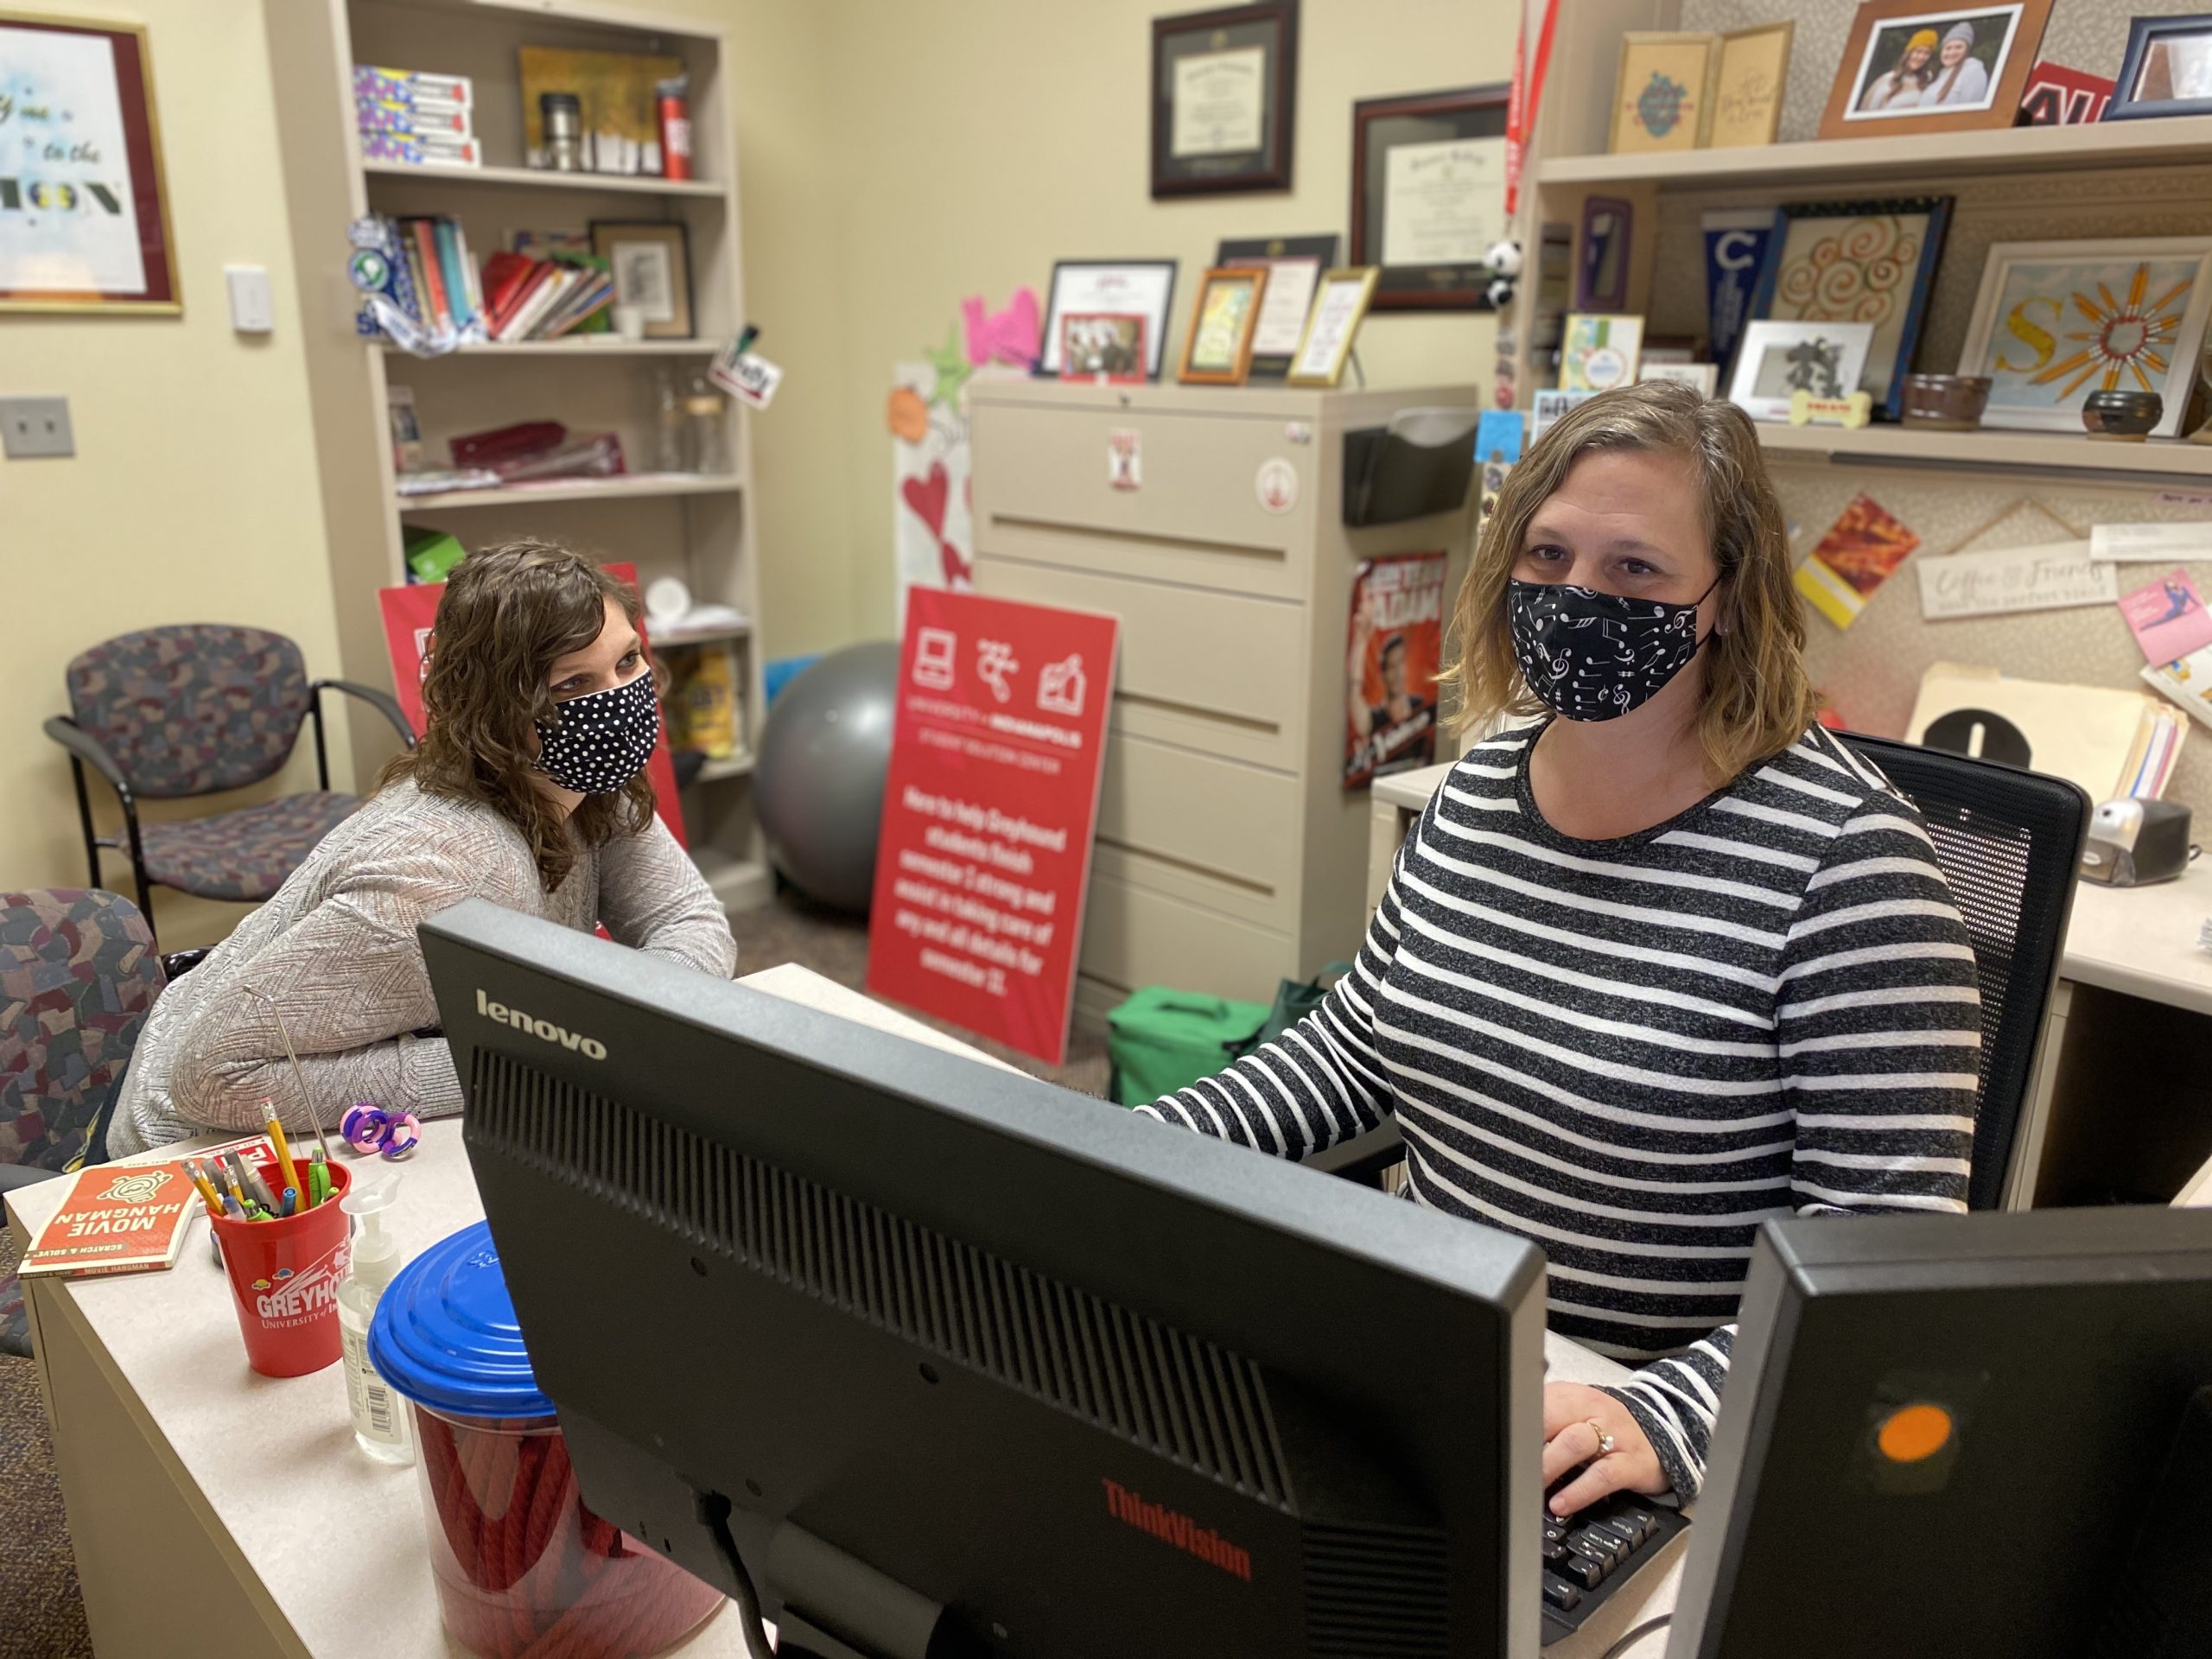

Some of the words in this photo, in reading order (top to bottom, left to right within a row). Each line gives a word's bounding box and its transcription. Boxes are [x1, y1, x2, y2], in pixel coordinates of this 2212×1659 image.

[903, 784, 936, 816] Here
[936, 795, 953, 821] to
[955, 798, 985, 833] help
[987, 807, 1067, 853] Greyhound
[925, 825, 988, 862] students
[989, 841, 1033, 876] finish
[899, 849, 963, 886] semester
[976, 873, 1024, 910] strong
[1025, 888, 1056, 916] and
[893, 878, 938, 907] assist
[954, 895, 1000, 932] taking
[1001, 912, 1033, 940] care
[1033, 922, 1053, 947] of
[894, 909, 921, 938] any
[922, 917, 950, 944] and
[950, 926, 969, 950] all
[969, 930, 1018, 969] details
[1018, 946, 1044, 976] for
[919, 948, 986, 988] semester
[476, 988, 607, 1060] lenovo
[54, 1203, 181, 1224] HANGMAN
[67, 1216, 156, 1237] MOVIE
[79, 1243, 123, 1254] SCRATCH
[111, 1263, 149, 1273] HANGMAN
[1102, 1478, 1252, 1583] ThinkVision
